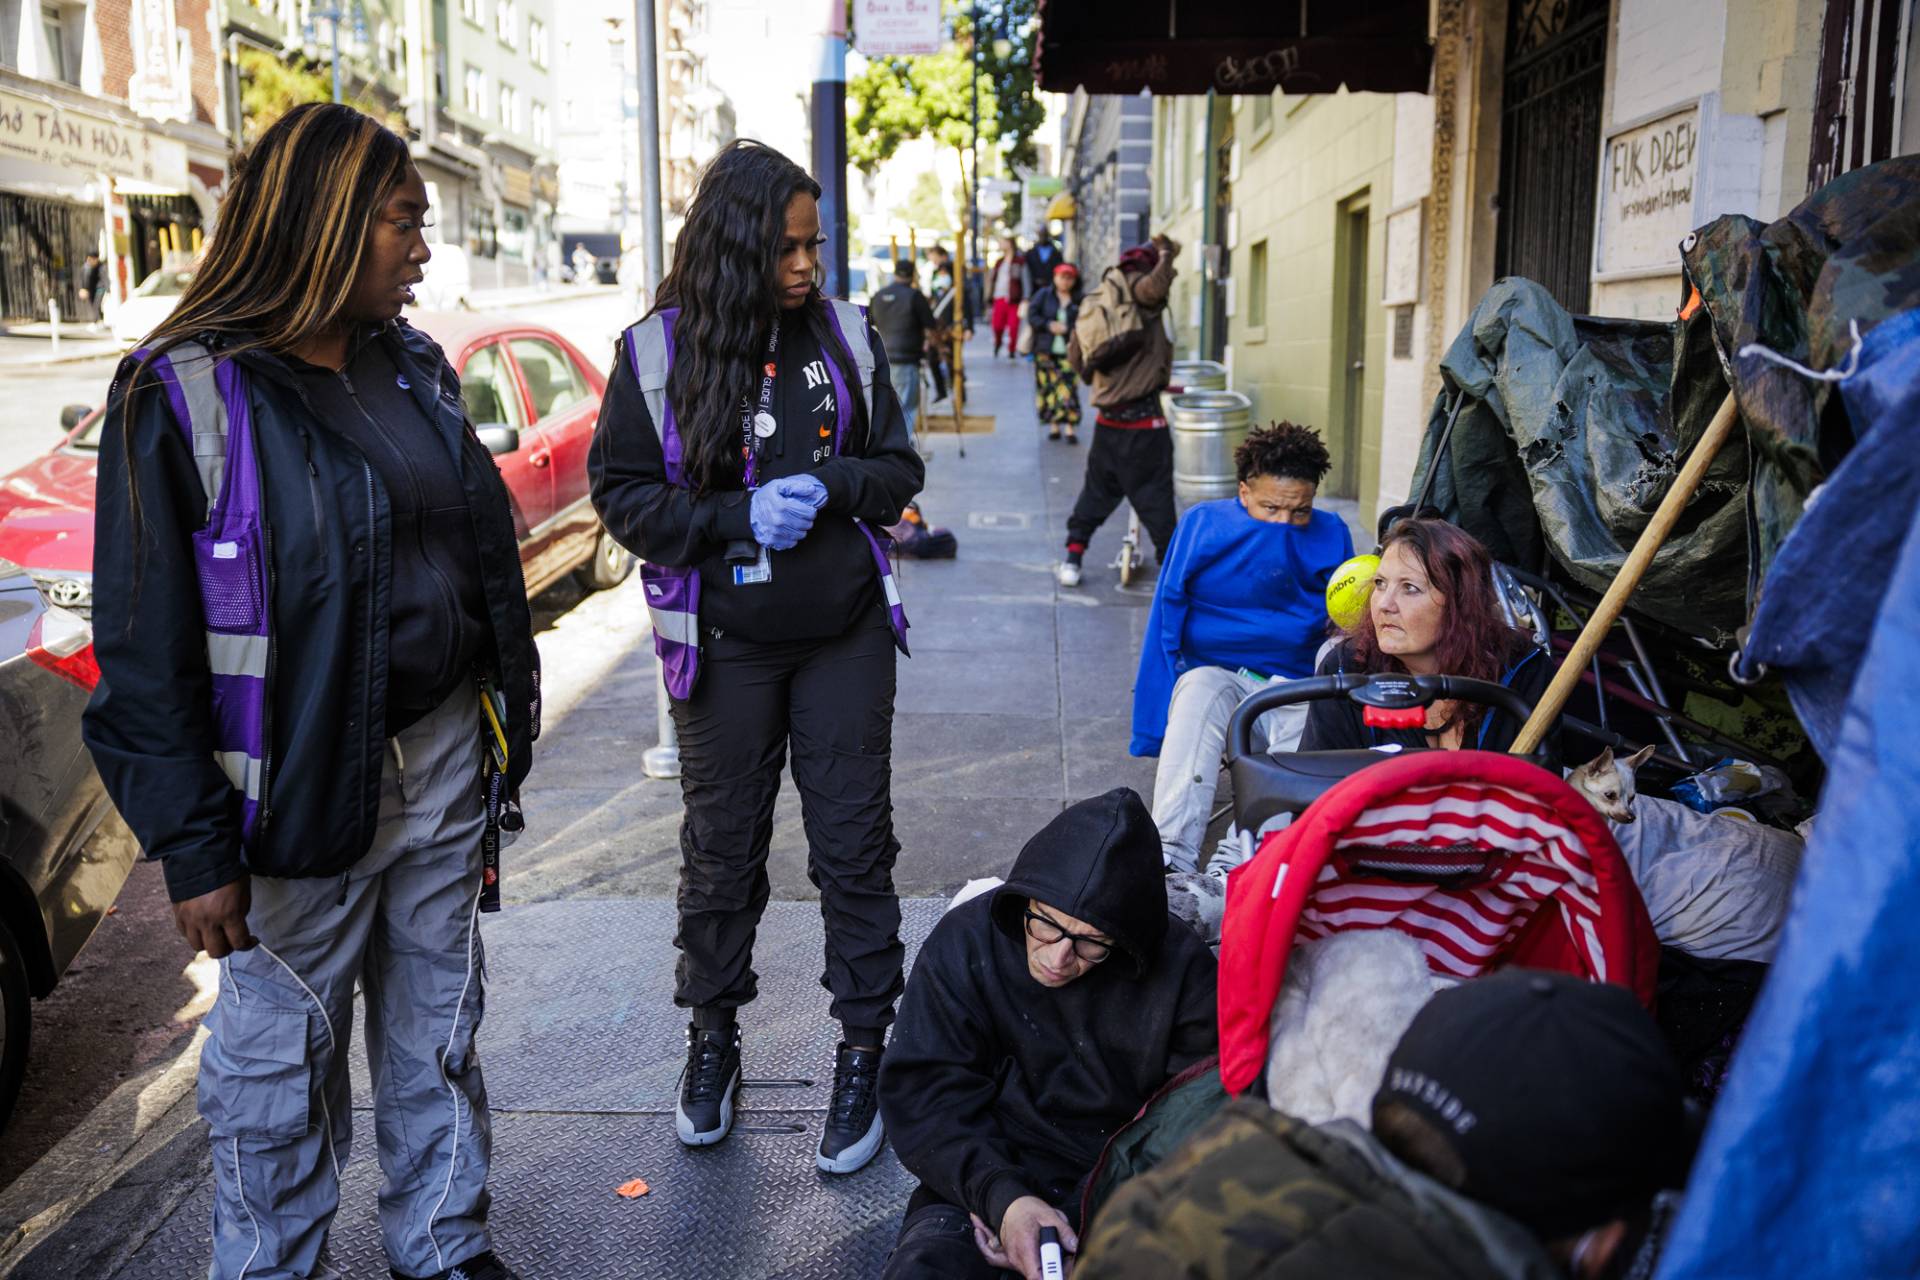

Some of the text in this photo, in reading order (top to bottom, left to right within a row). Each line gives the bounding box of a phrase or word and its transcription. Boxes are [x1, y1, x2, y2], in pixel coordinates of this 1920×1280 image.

[1612, 139, 1645, 192] FUK
[486, 771, 501, 865] GLIDE Celebration
